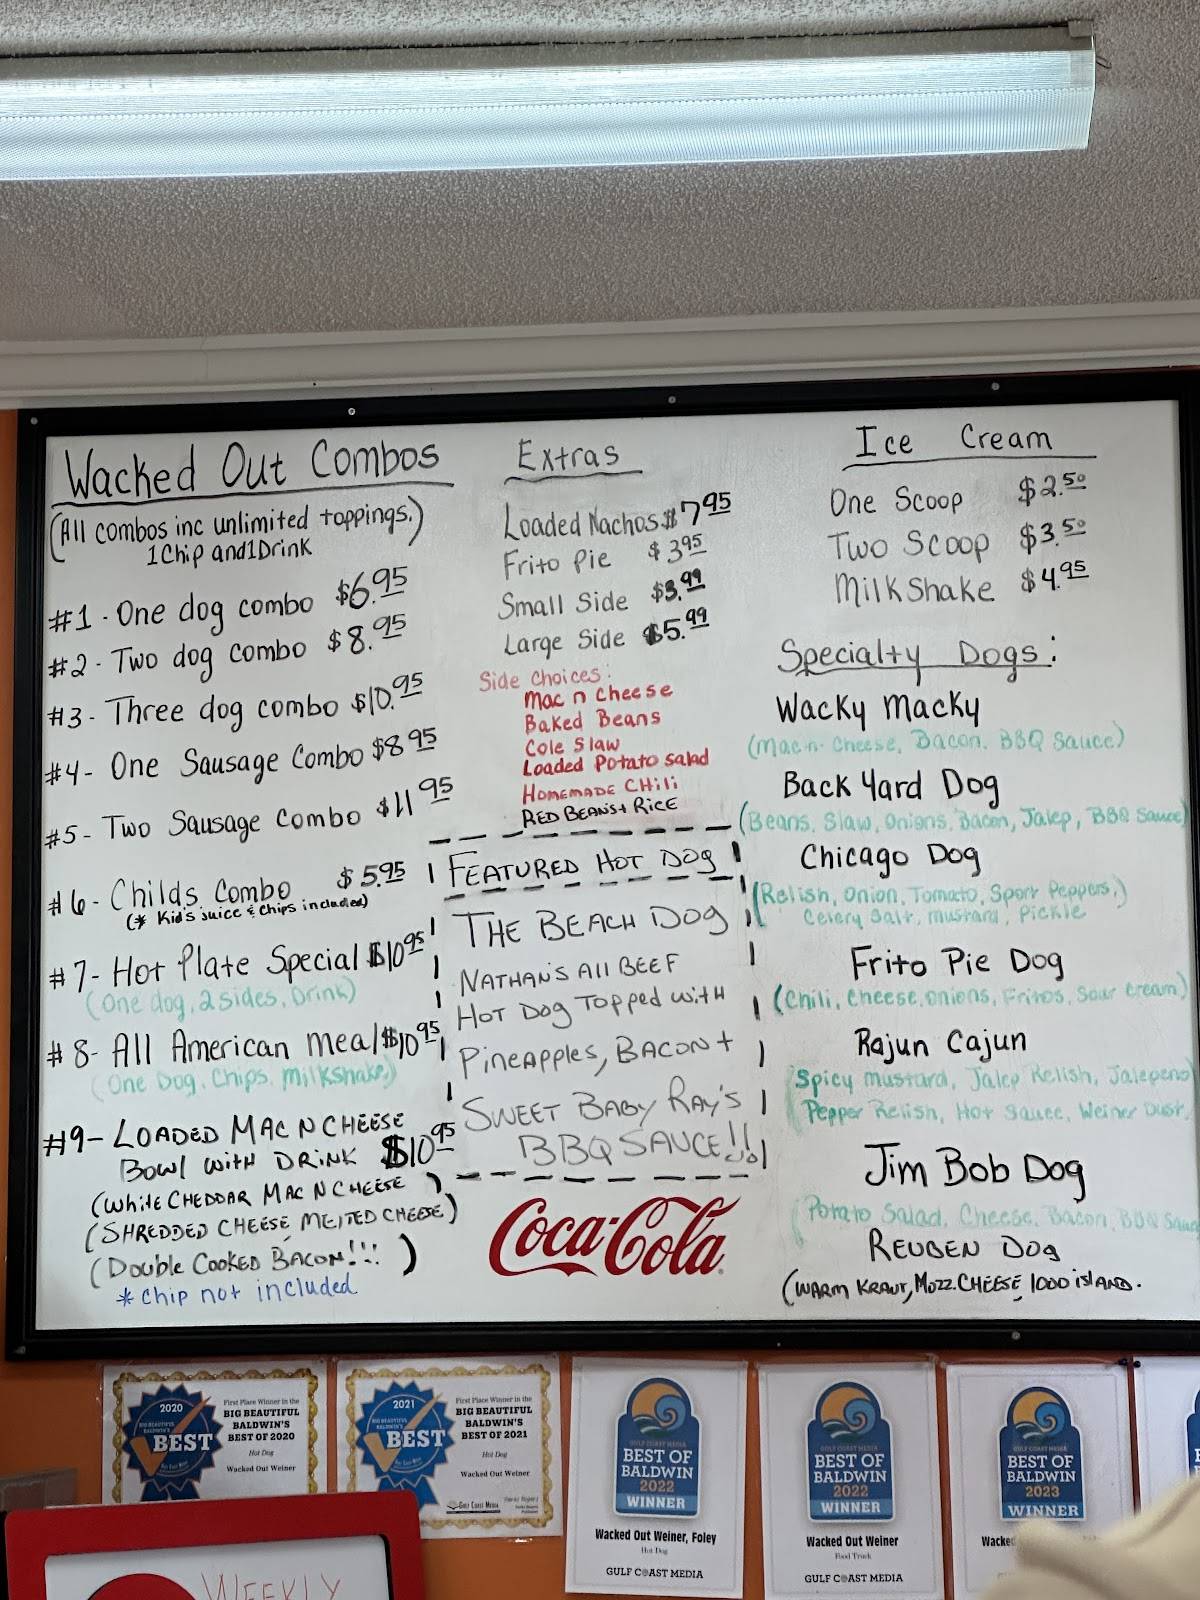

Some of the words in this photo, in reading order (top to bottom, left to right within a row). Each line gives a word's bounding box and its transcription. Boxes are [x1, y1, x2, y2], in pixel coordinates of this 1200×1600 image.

[856, 426, 913, 457] Ice
[962, 423, 1052, 450] Cream
[519, 439, 619, 470] Extras
[65, 444, 195, 499] Wacked
[222, 442, 287, 489] Out
[312, 439, 440, 478] Combos
[831, 489, 876, 516] One
[895, 486, 963, 514] Scoop
[96, 518, 168, 544] combos
[177, 513, 204, 537] inc
[214, 504, 308, 535] unlimited
[504, 502, 580, 540] Loaded
[589, 505, 658, 536] Nachos
[827, 531, 888, 560] Two
[903, 530, 990, 563] Scoop
[504, 549, 560, 580] Frito
[574, 550, 611, 574] Pie
[117, 600, 165, 627] One
[179, 592, 223, 636] dog
[239, 593, 313, 617] combo
[498, 592, 562, 619] Small
[576, 591, 628, 613] Side
[505, 634, 562, 659] Large
[578, 629, 625, 650] Side
[111, 647, 157, 673] Two
[173, 644, 213, 683] dog
[230, 640, 306, 663] combo
[778, 639, 921, 686] Specialty
[479, 672, 520, 691] Side
[105, 695, 184, 726] Three
[200, 694, 243, 732] dog
[258, 693, 339, 718] combo
[526, 711, 582, 733] Baked
[596, 709, 661, 727] Beans
[777, 692, 866, 730] Wacky
[526, 739, 563, 756] Cole
[574, 737, 620, 752] Slaw
[1000, 730, 1043, 752] BBQ
[112, 752, 159, 780] One
[180, 748, 279, 784] Sausage
[523, 757, 583, 776] Loaded
[596, 755, 659, 772] Potato
[523, 784, 615, 804] HOMEMADE
[784, 771, 850, 799] Back
[861, 769, 922, 800] Yard
[942, 768, 999, 809] Dog
[102, 815, 150, 840] Two
[169, 809, 260, 843] Sausage
[522, 809, 560, 827] RED
[1087, 807, 1130, 824] BBQ
[450, 851, 579, 887] FEATURED
[801, 845, 909, 878] Chicago
[928, 843, 981, 877] Dog
[452, 911, 521, 947] THE
[536, 910, 635, 940] BEACH
[113, 956, 165, 988] Hot
[178, 943, 249, 981] Plate
[267, 943, 358, 984] Special
[620, 954, 679, 976] BEEF
[851, 945, 927, 980] Frito
[941, 947, 990, 977] Pie
[1011, 947, 1064, 982] Dog
[113, 1033, 151, 1067] All
[172, 1029, 289, 1062] American
[616, 1036, 710, 1063] BACON
[855, 1028, 929, 1064] Rajun
[947, 1029, 1027, 1062] Cajun
[462, 1097, 560, 1131] SWEET
[806, 1102, 863, 1125] Pepper
[113, 1119, 219, 1150] LOADED
[231, 1115, 290, 1145] MAC
[323, 1113, 404, 1136] CHEESE
[518, 1134, 612, 1166] BBQ
[864, 1142, 928, 1187] Jim
[936, 1147, 1009, 1186] Bob
[1025, 1153, 1085, 1203] Dog
[168, 1191, 251, 1208] CHEDDAR
[806, 1196, 872, 1223] Potato
[489, 1196, 741, 1277] Coca-Cola
[869, 1227, 979, 1262] REUBEN
[201, 1284, 240, 1303] not
[258, 1273, 358, 1303] included
[160, 1404, 183, 1412] 2020
[224, 1410, 241, 1418] BIG
[244, 1409, 300, 1417] BEAUTIFUL
[392, 1400, 415, 1409] 2021
[476, 1406, 533, 1415] BEAUTIFUL
[233, 1421, 290, 1429] BALDWIN'S
[465, 1419, 523, 1427] BALDWIN'S
[153, 1434, 213, 1452] BEST
[387, 1430, 445, 1448] BEST
[461, 1432, 487, 1440] BEST
[503, 1430, 527, 1439] 2021
[623, 1449, 665, 1463] BEST
[669, 1450, 692, 1464] OF
[815, 1454, 857, 1468] BEST
[862, 1454, 884, 1467] OF
[1008, 1455, 1047, 1468] BEST
[1052, 1455, 1073, 1468] OF
[622, 1465, 694, 1479] BALDWIN
[814, 1471, 887, 1483] BALDWIN
[1007, 1471, 1076, 1482] BALDWIN
[640, 1480, 674, 1492] 2022
[833, 1485, 868, 1497] 2022
[1025, 1486, 1059, 1497] 2023
[627, 1496, 685, 1509] WINNER
[821, 1501, 880, 1513] WINNER
[1008, 1505, 1079, 1516] WINNER
[595, 1529, 631, 1540] Wacked
[634, 1530, 650, 1541] Out
[654, 1530, 688, 1544] Weiner,
[692, 1532, 716, 1545] Foley
[807, 1536, 842, 1547] Wacked
[846, 1536, 863, 1547] Out
[866, 1536, 899, 1546] Weiner
[606, 1568, 632, 1576] GULF
[670, 1570, 703, 1578] MEDIA
[805, 1575, 831, 1583] GULF
[870, 1574, 903, 1582] MEDIA
